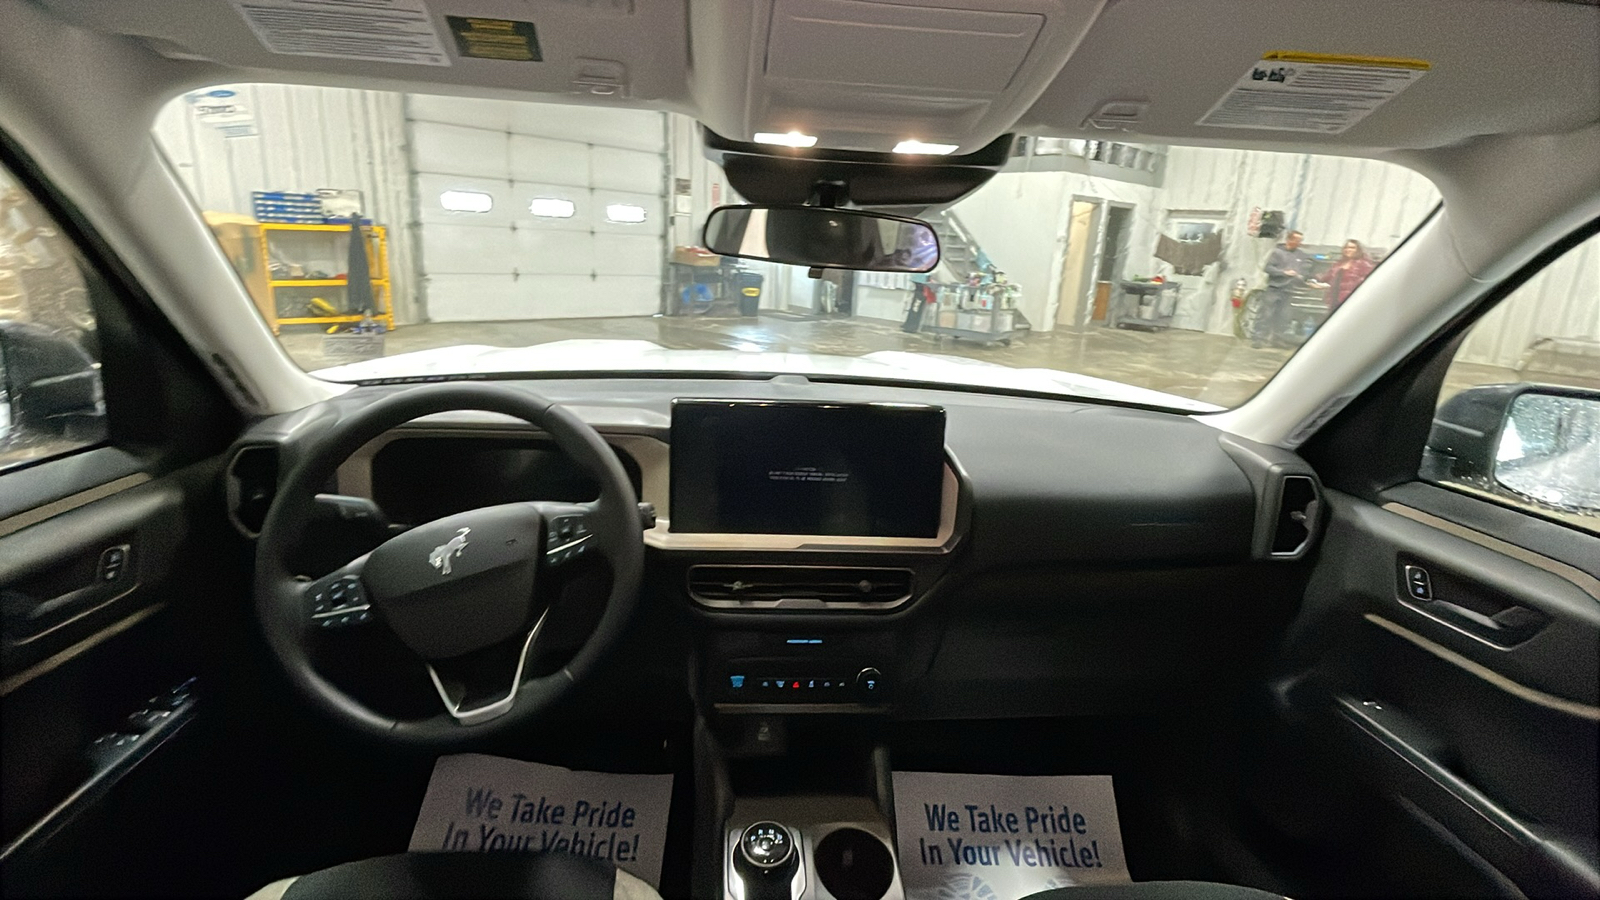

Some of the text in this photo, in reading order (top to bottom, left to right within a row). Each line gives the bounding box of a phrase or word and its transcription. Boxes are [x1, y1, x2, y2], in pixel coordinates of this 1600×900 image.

[466, 787, 636, 828] We Take Pride
[924, 803, 1087, 835] We Take Pride
[919, 836, 1103, 868] In Your Vehicle!
